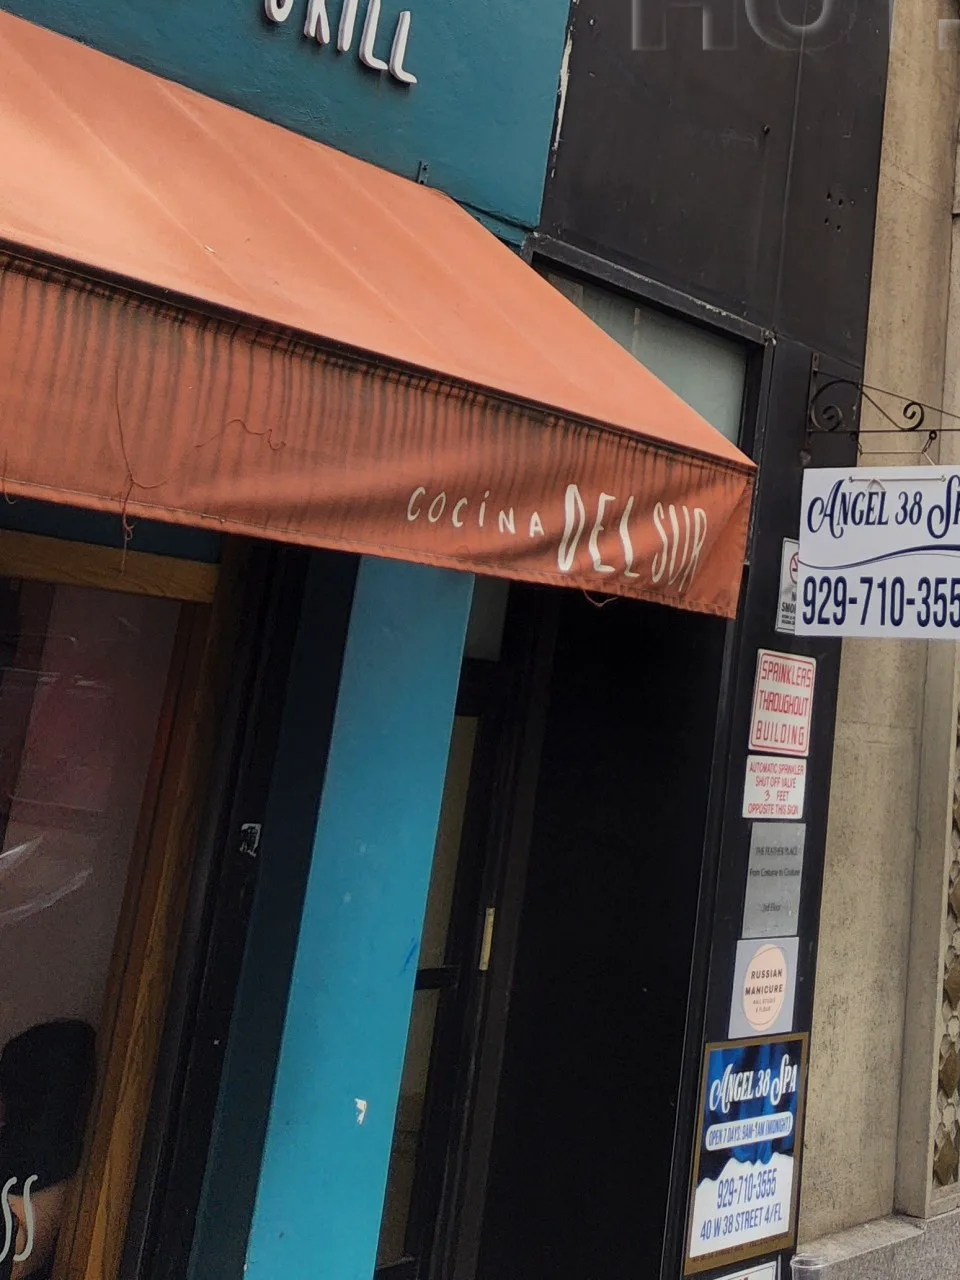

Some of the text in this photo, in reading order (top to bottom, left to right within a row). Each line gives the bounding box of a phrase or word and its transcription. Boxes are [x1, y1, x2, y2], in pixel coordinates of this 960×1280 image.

[807, 478, 889, 539] ANGEL
[894, 491, 923, 526] 38
[557, 484, 640, 577] DEL
[651, 501, 708, 593] SUR
[761, 660, 812, 688] SPRINKLERS
[759, 690, 809, 717] THROUGHOUT
[756, 720, 804, 746] BUILDING
[777, 790, 790, 801] FEET
[751, 968, 782, 979] RUSSIAN
[745, 984, 783, 995] MANICURE
[709, 1054, 797, 1113] ANGEL 38 SPA
[709, 1128, 722, 1146] OPEN
[717, 1168, 777, 1209] 929-710-3555
[700, 1202, 782, 1240] 40 W 38 STREET 4/FL
